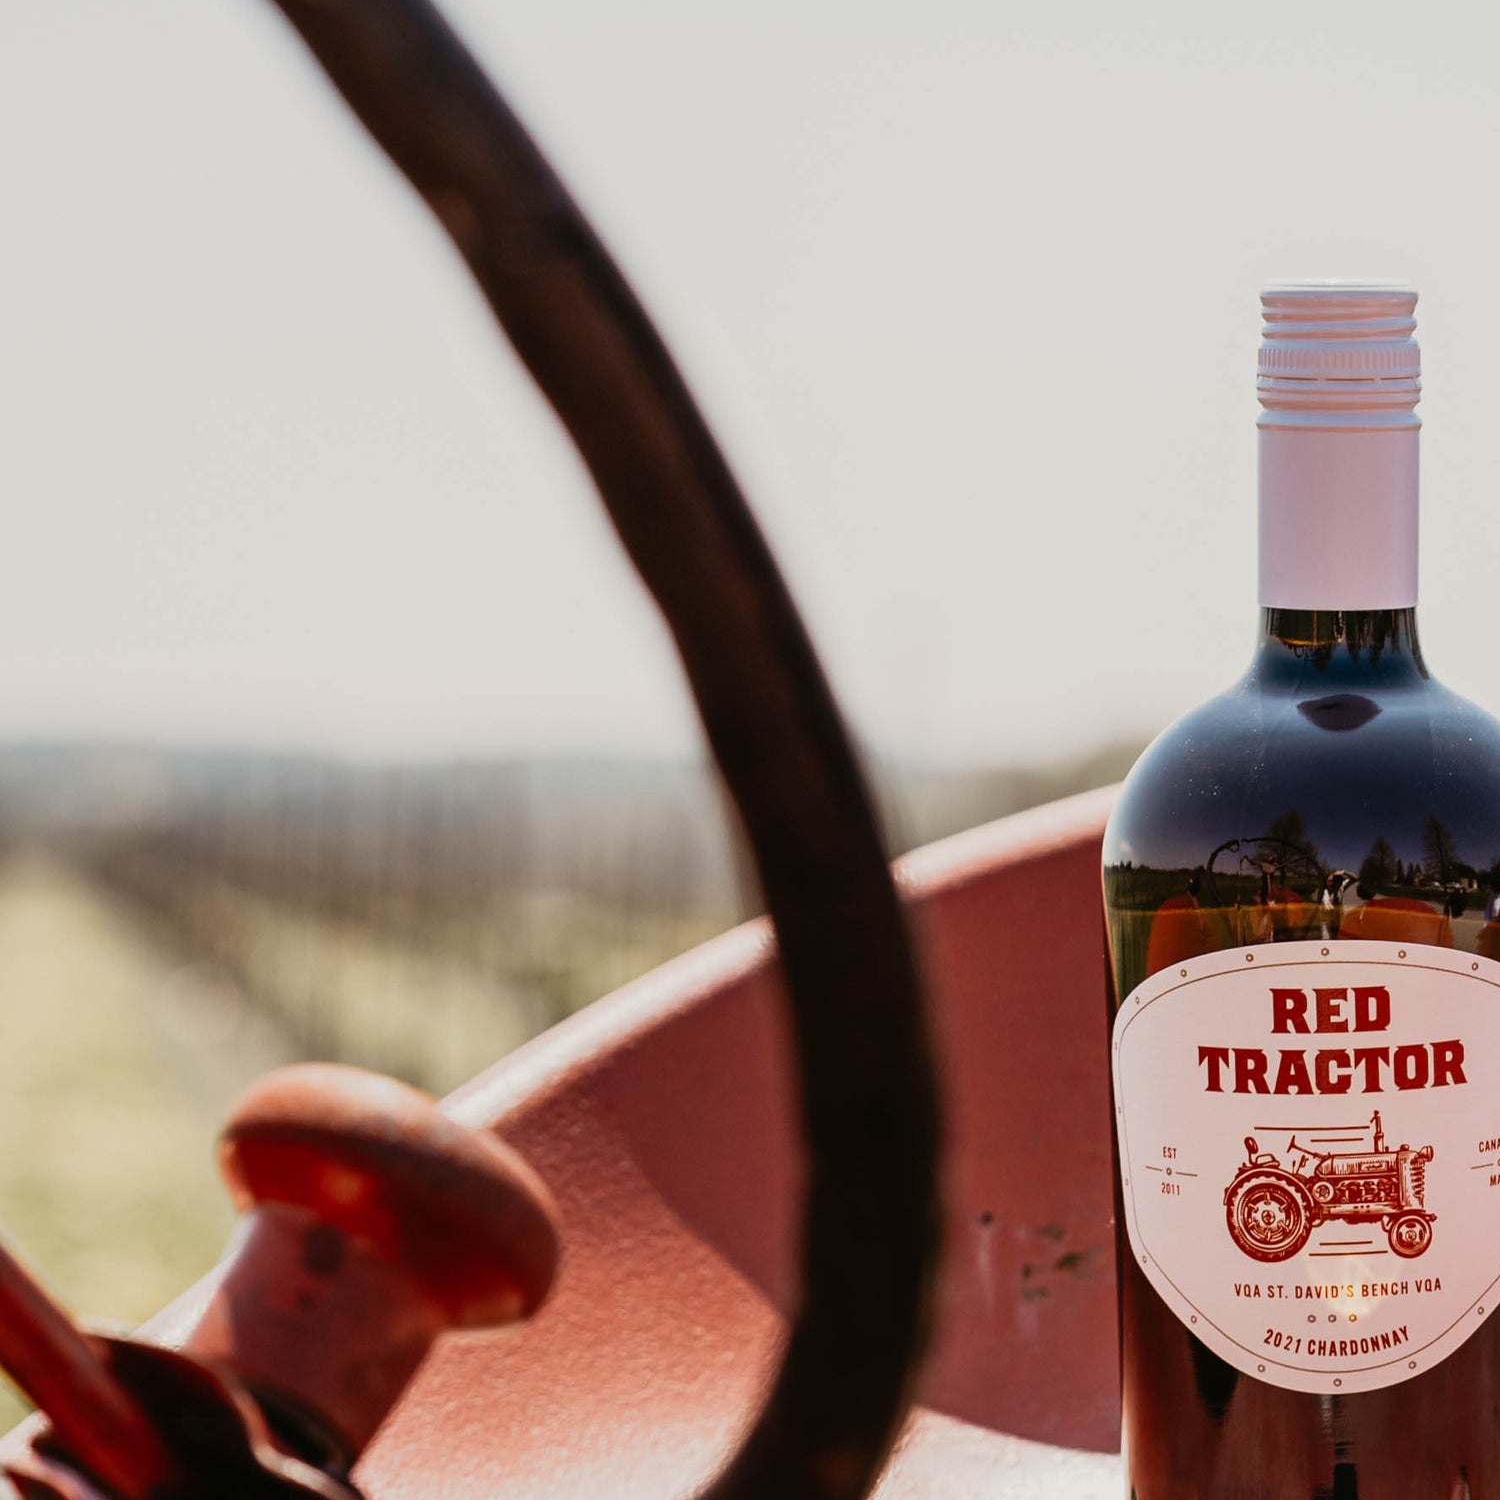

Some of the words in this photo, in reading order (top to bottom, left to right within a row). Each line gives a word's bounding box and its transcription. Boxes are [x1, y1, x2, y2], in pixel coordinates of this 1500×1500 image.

[1269, 986, 1391, 1035] RED
[1197, 1039, 1467, 1095] TRACTOR
[1162, 1146, 1177, 1160] EST
[1161, 1182, 1181, 1196] 2011
[1234, 1283, 1261, 1299] VQA
[1268, 1285, 1289, 1299] ST.
[1295, 1284, 1355, 1299] DAVID'S
[1361, 1281, 1409, 1298] BENCH
[1415, 1278, 1442, 1294] VQA
[1263, 1329, 1302, 1354] 2021
[1307, 1326, 1410, 1356] CHARDONNAY
